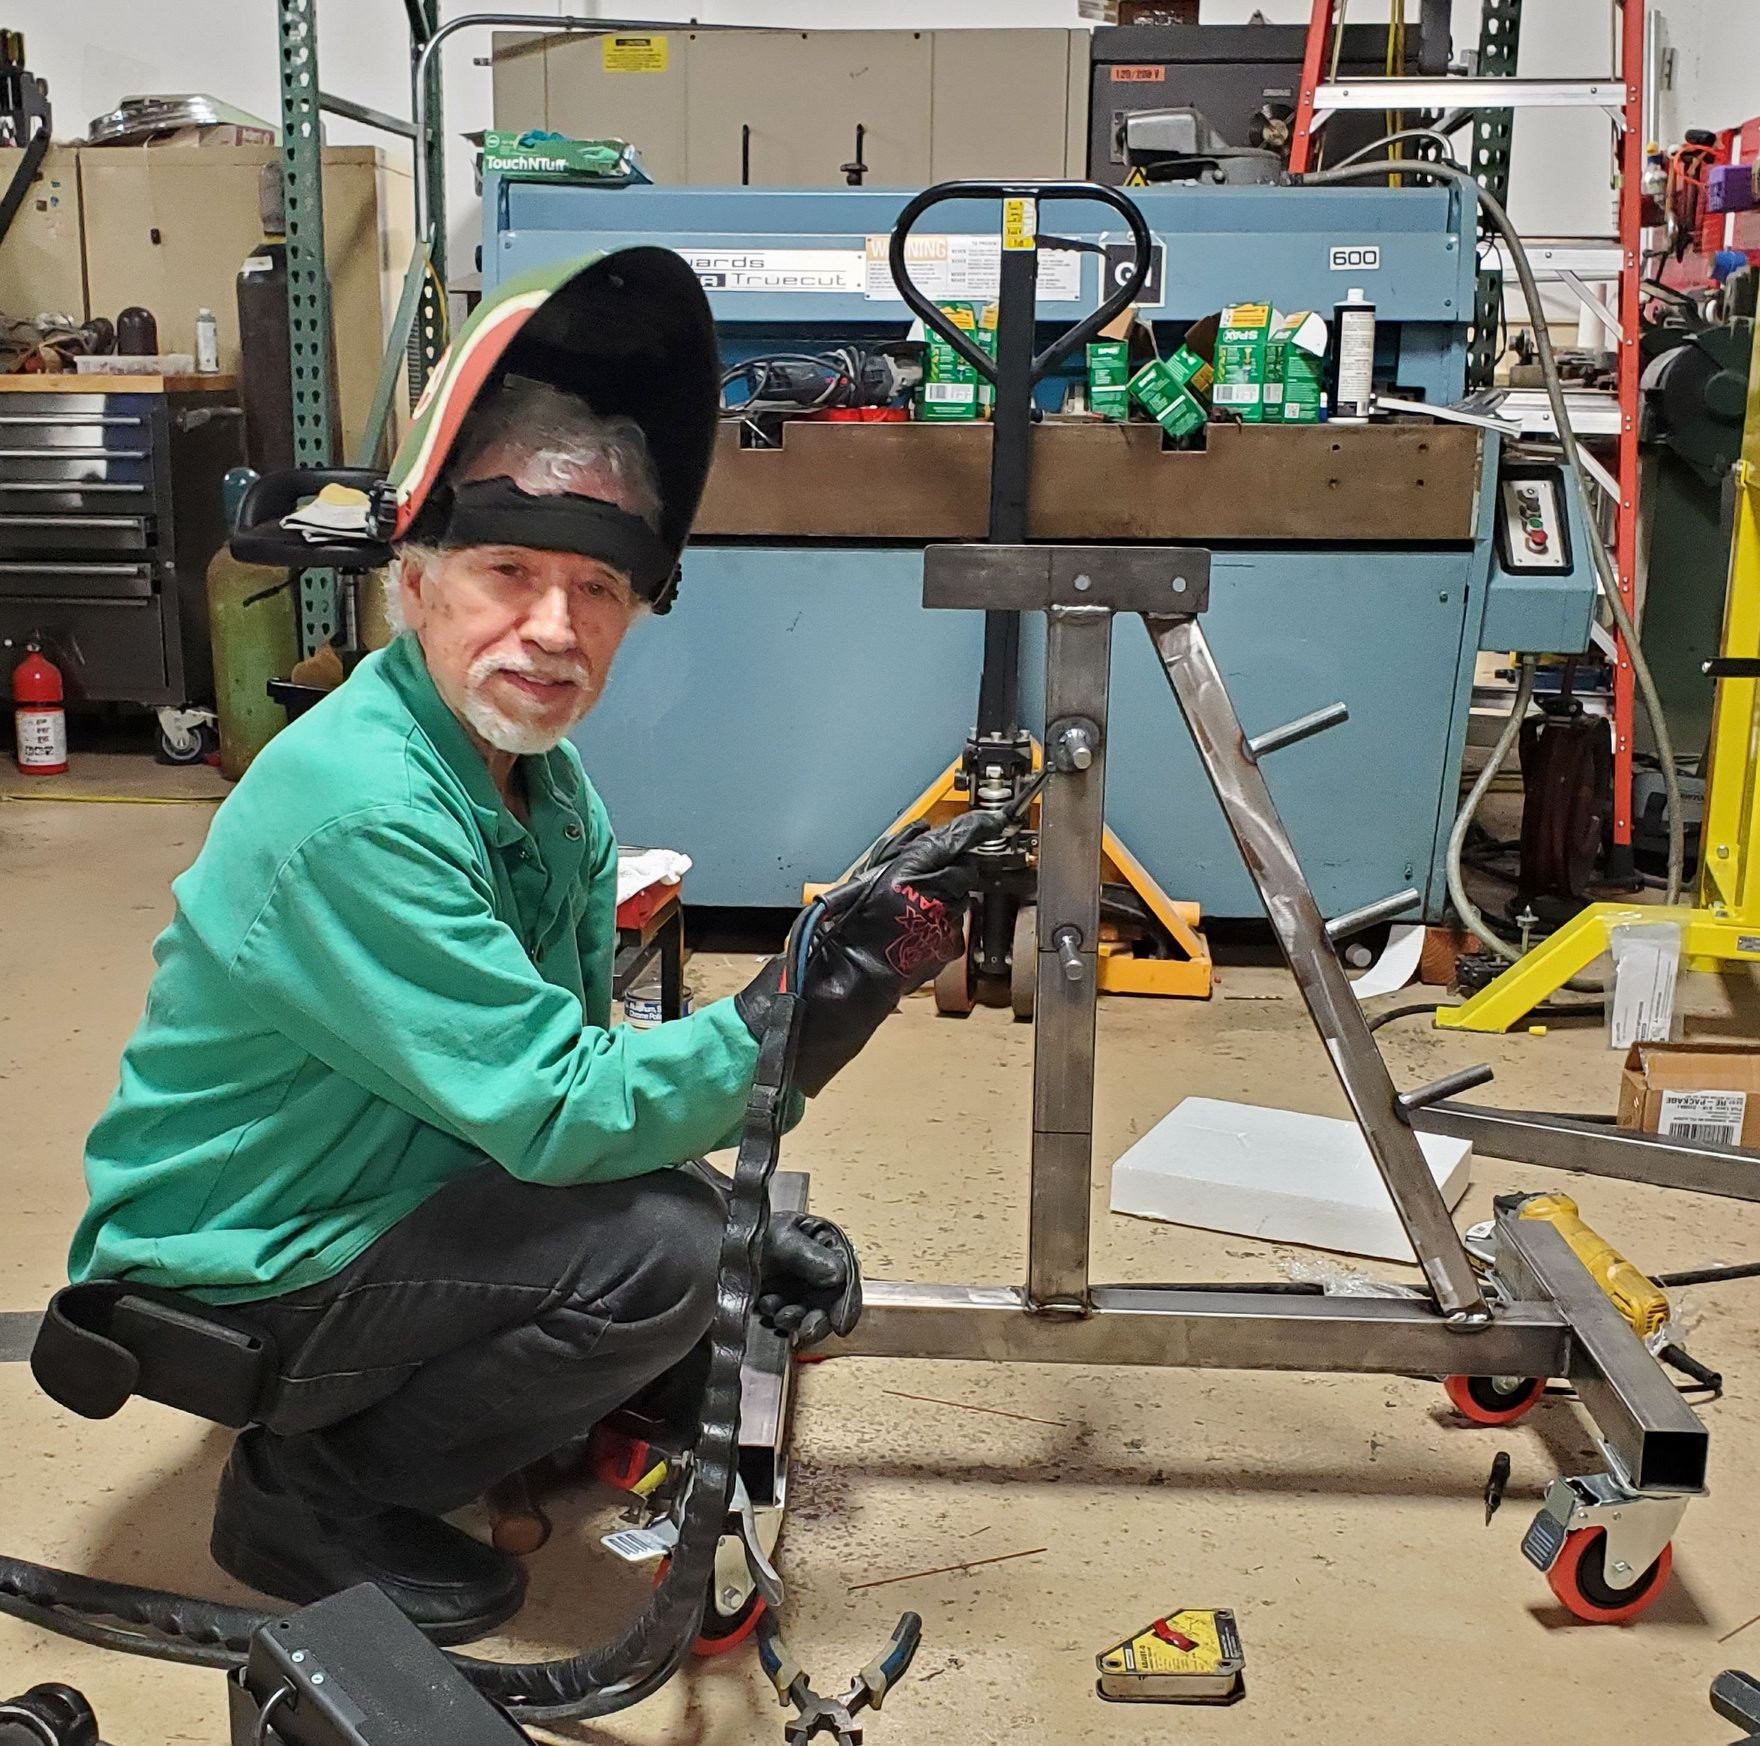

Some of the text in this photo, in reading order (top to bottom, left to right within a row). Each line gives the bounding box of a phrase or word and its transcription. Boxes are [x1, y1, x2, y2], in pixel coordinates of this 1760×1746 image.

[486, 155, 567, 171] TouchNTuff
[871, 239, 947, 259] WNING
[1333, 250, 1377, 265] 600
[730, 273, 847, 286] Truecut
[1665, 1097, 1706, 1106] PACKAGE
